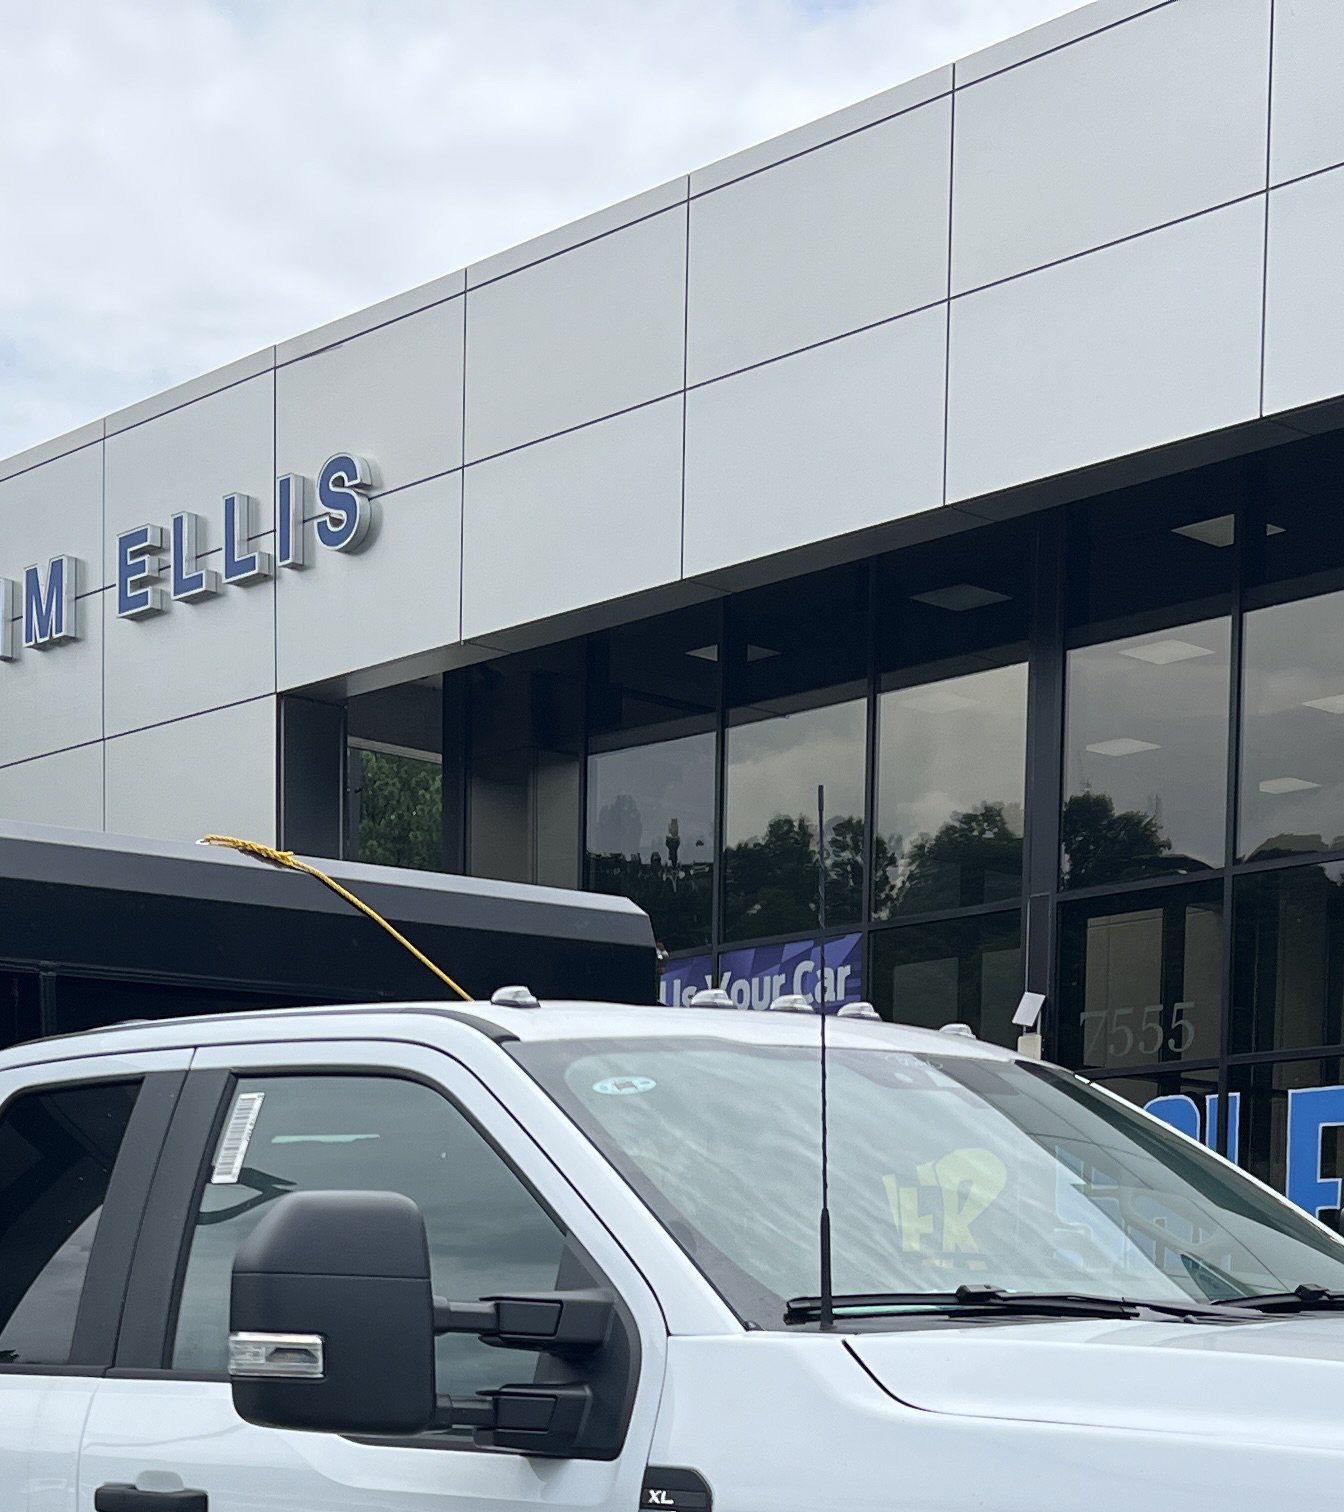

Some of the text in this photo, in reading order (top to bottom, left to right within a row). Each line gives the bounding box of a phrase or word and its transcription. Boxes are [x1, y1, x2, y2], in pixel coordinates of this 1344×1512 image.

[116, 451, 380, 619] ELLIS
[705, 971, 786, 1011] Your
[793, 960, 851, 1005] Car
[1080, 1001, 1196, 1062] 7555
[648, 1489, 674, 1505] XL
